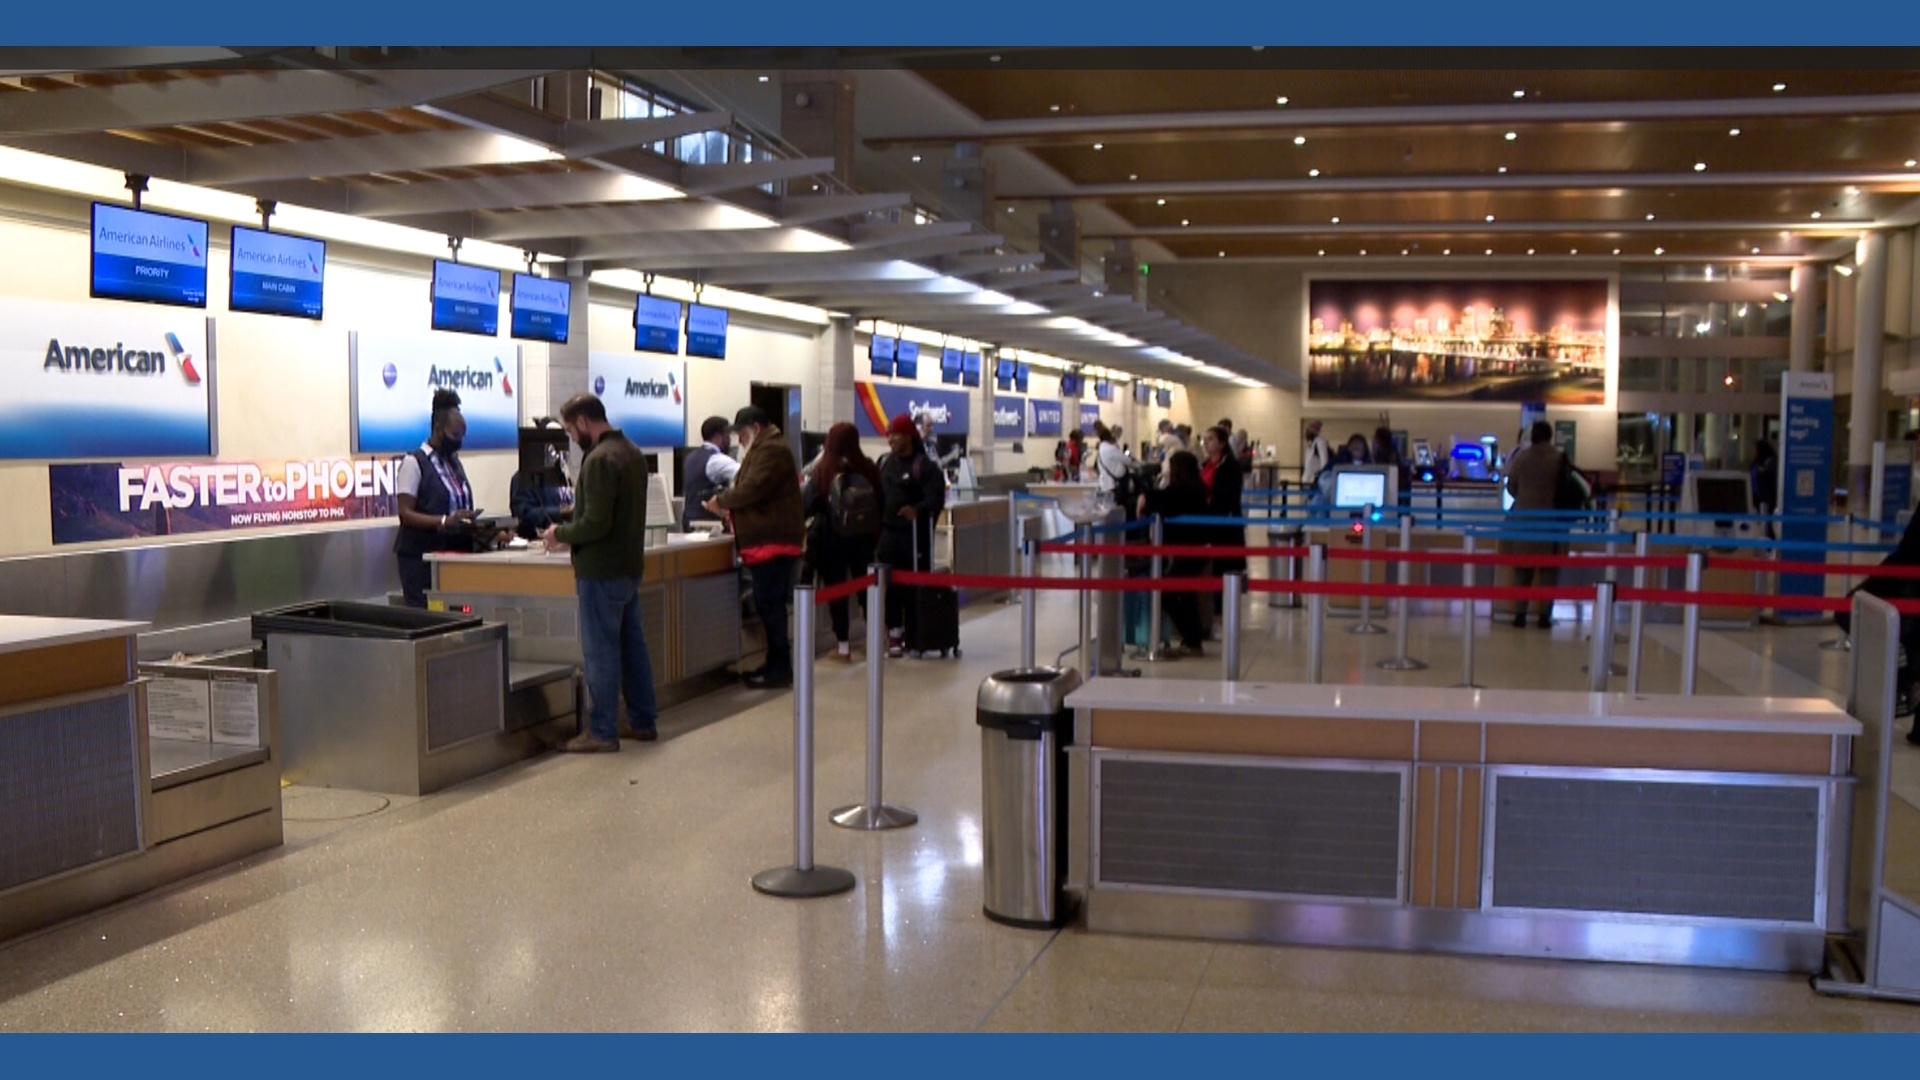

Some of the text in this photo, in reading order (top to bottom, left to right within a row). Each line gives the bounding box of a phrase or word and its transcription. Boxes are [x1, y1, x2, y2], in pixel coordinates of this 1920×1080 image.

[99, 227, 186, 253] American Airlines
[237, 248, 307, 269] American Airlines
[135, 265, 170, 279] PRIORITY
[262, 281, 296, 294] MAIN CABIN
[44, 338, 166, 374] American
[428, 364, 493, 389] American
[625, 377, 669, 398] American
[1038, 409, 1061, 424] UNITED
[117, 463, 262, 512] FASTER
[263, 475, 287, 502] to
[231, 507, 345, 525] NOW FLYING NONSTOP TO PHX
